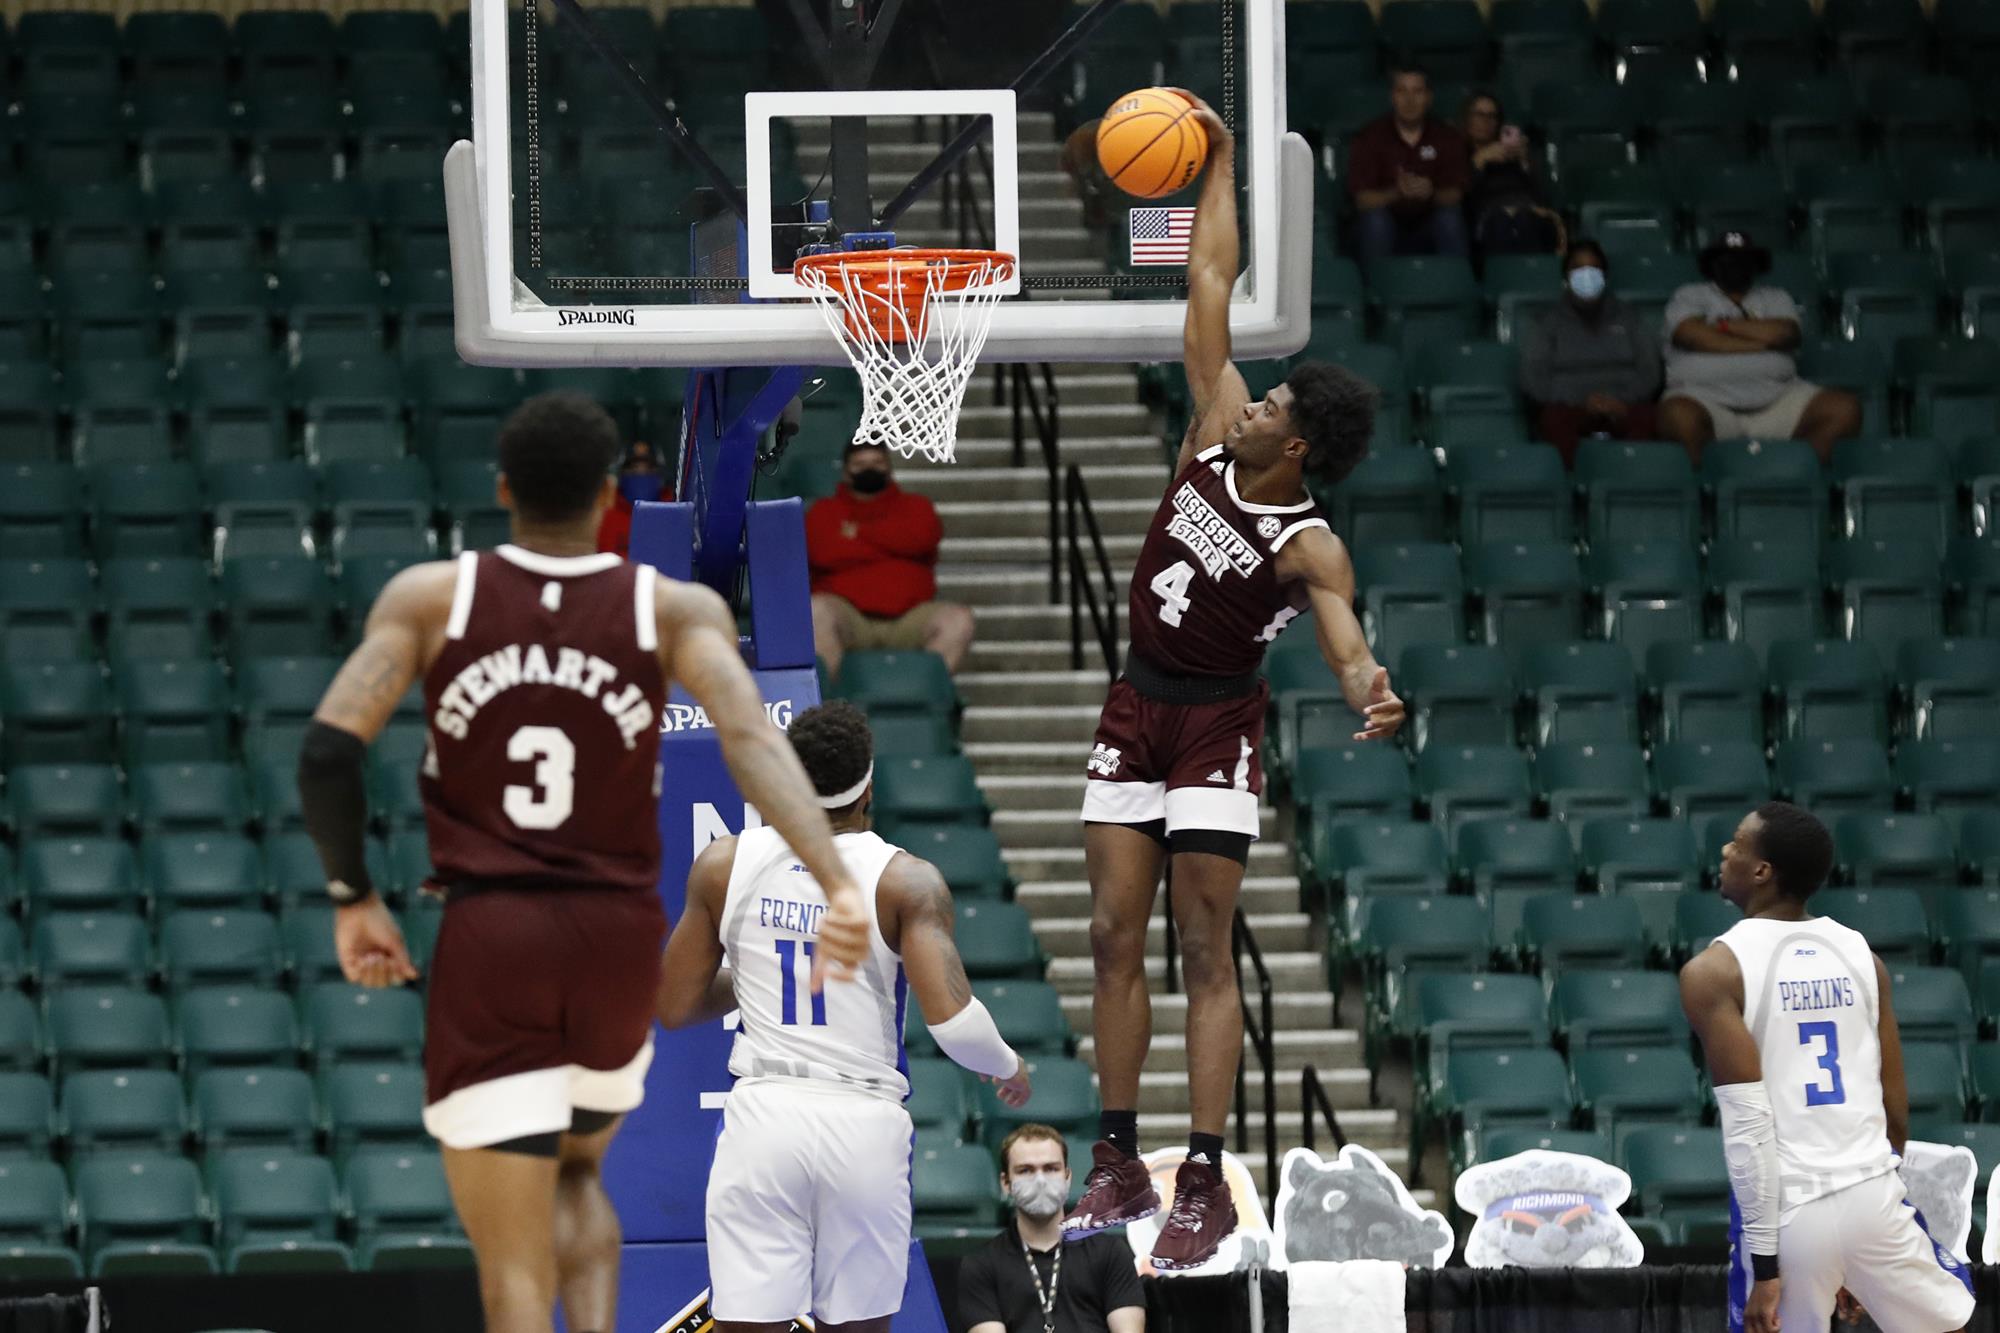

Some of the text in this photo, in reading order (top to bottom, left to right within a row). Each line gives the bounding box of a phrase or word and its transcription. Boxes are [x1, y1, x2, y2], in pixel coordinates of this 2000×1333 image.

[558, 309, 635, 326] SPALDING
[1174, 484, 1262, 576] MISSISSIPPI
[1176, 523, 1217, 567] STATE
[1259, 516, 1280, 538] SEC
[1150, 560, 1196, 628] 4
[434, 643, 654, 750] STEWART JR.
[503, 725, 576, 830] 3
[761, 898, 830, 934] FRENC
[775, 939, 828, 1026] 11
[1778, 976, 1855, 1012] PERKINS
[1797, 1020, 1846, 1107] 3
[1512, 1192, 1585, 1211] RICHMOND
